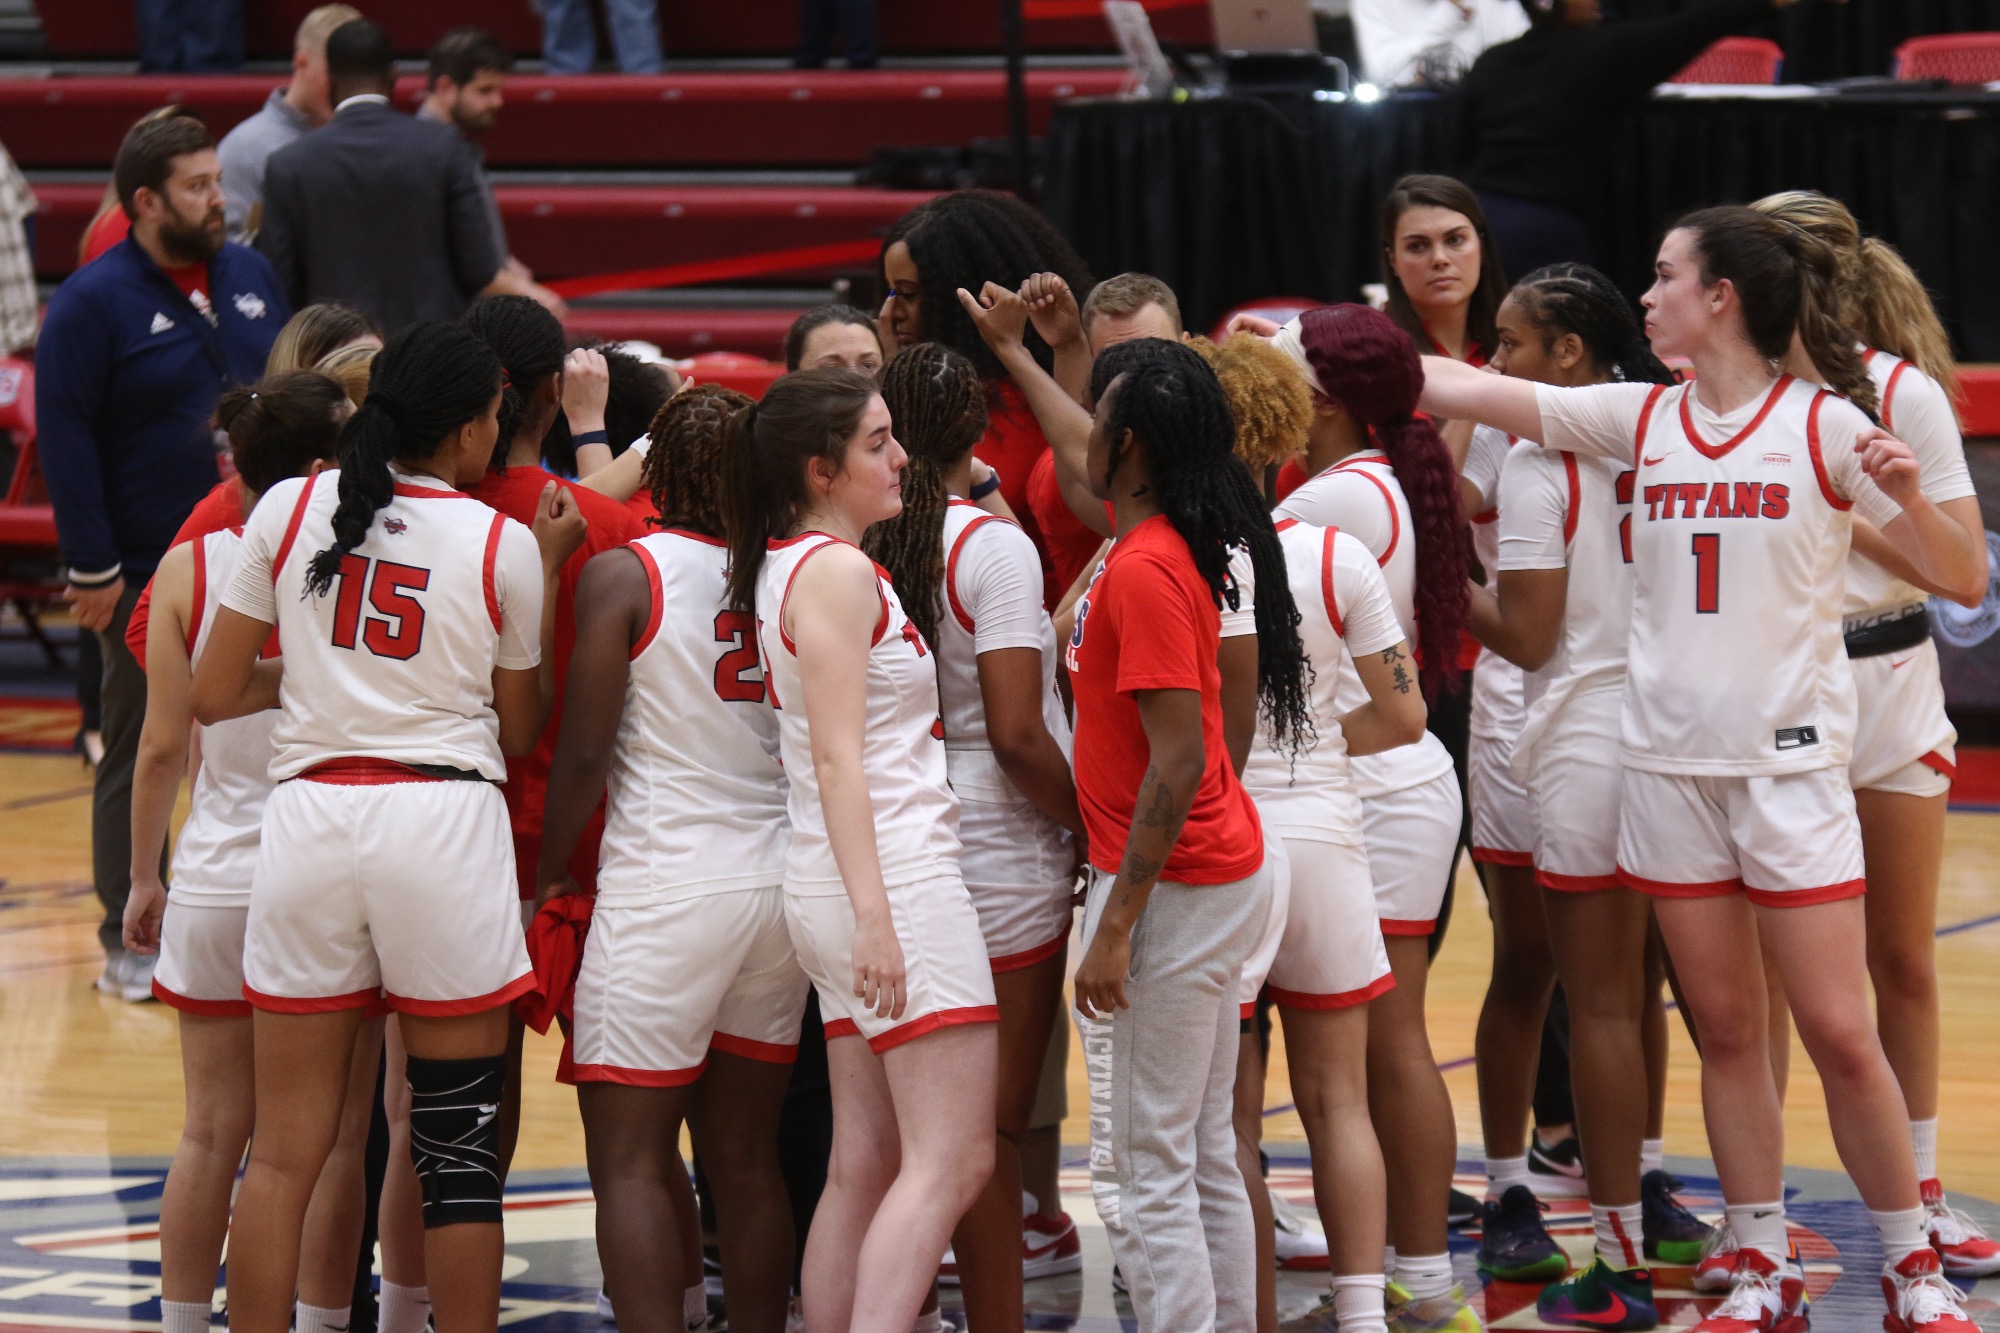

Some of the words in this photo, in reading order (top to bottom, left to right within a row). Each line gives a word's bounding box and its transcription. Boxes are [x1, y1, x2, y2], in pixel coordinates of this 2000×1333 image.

[1644, 482, 1790, 521] TITANS
[331, 552, 431, 661] 15
[1692, 533, 1720, 614] 1
